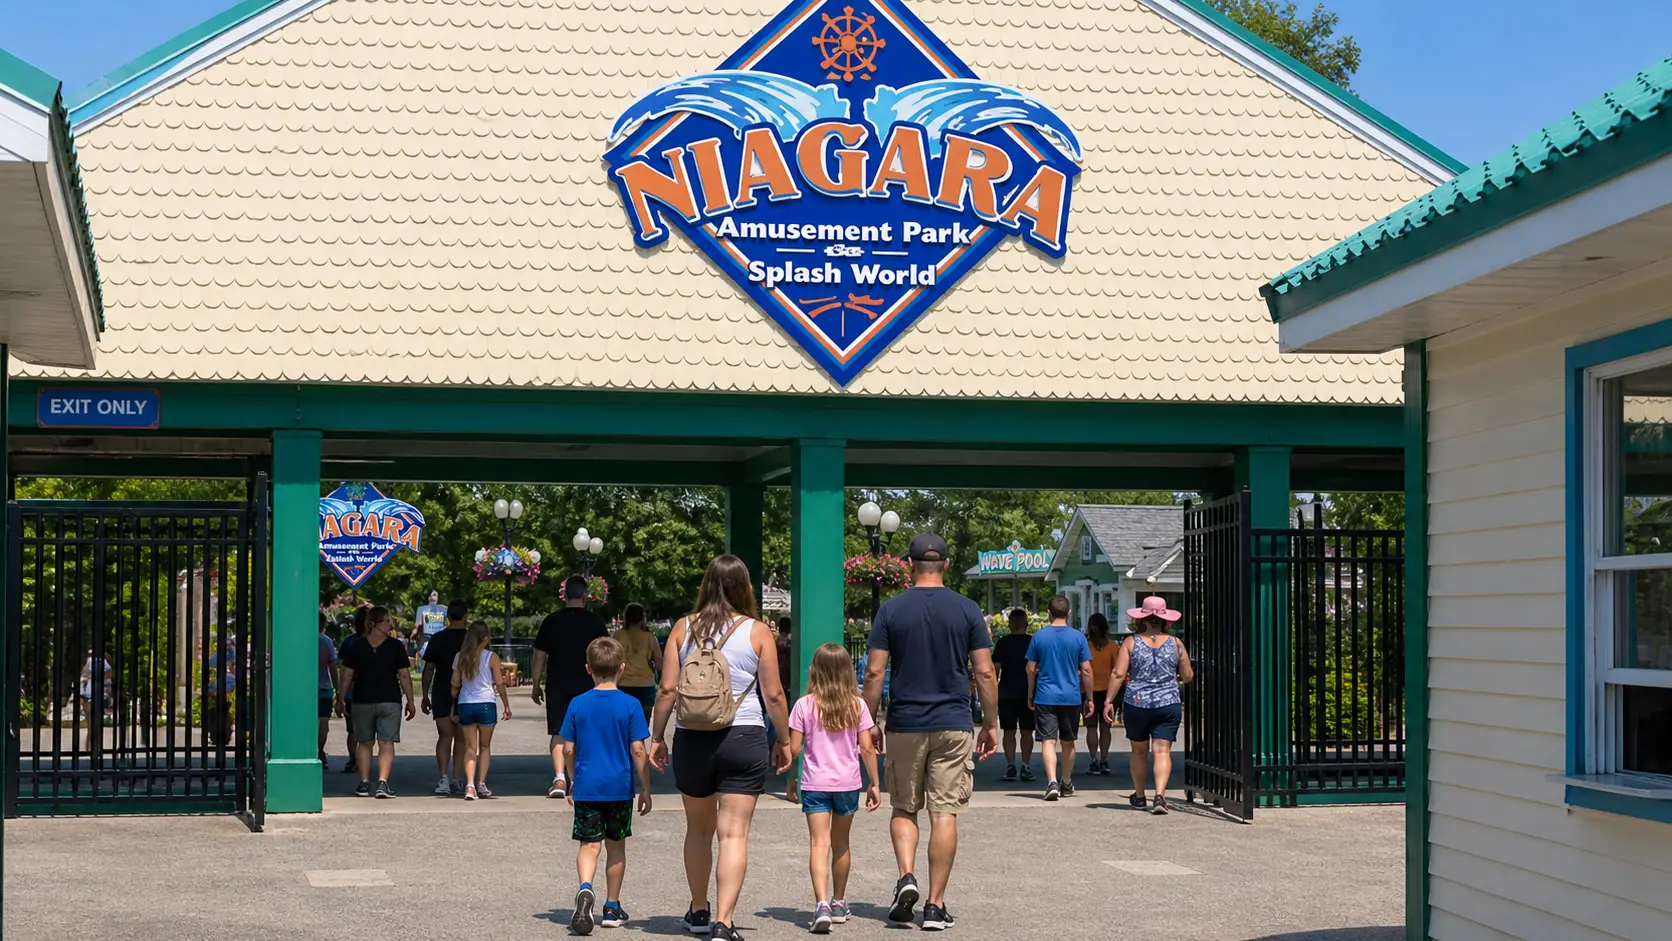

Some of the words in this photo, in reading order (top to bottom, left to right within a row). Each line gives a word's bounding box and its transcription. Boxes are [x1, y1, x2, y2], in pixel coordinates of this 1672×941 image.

[616, 121, 1067, 251] NIAGARA
[716, 216, 892, 241] Amusement
[903, 221, 971, 244] Park
[749, 261, 841, 288] Splash
[851, 264, 936, 286] World
[50, 398, 92, 414] EXIT
[97, 399, 148, 415] ONLY
[319, 511, 420, 553] AGARA
[981, 552, 1014, 571] WAVE
[1016, 551, 1049, 572] POOL
